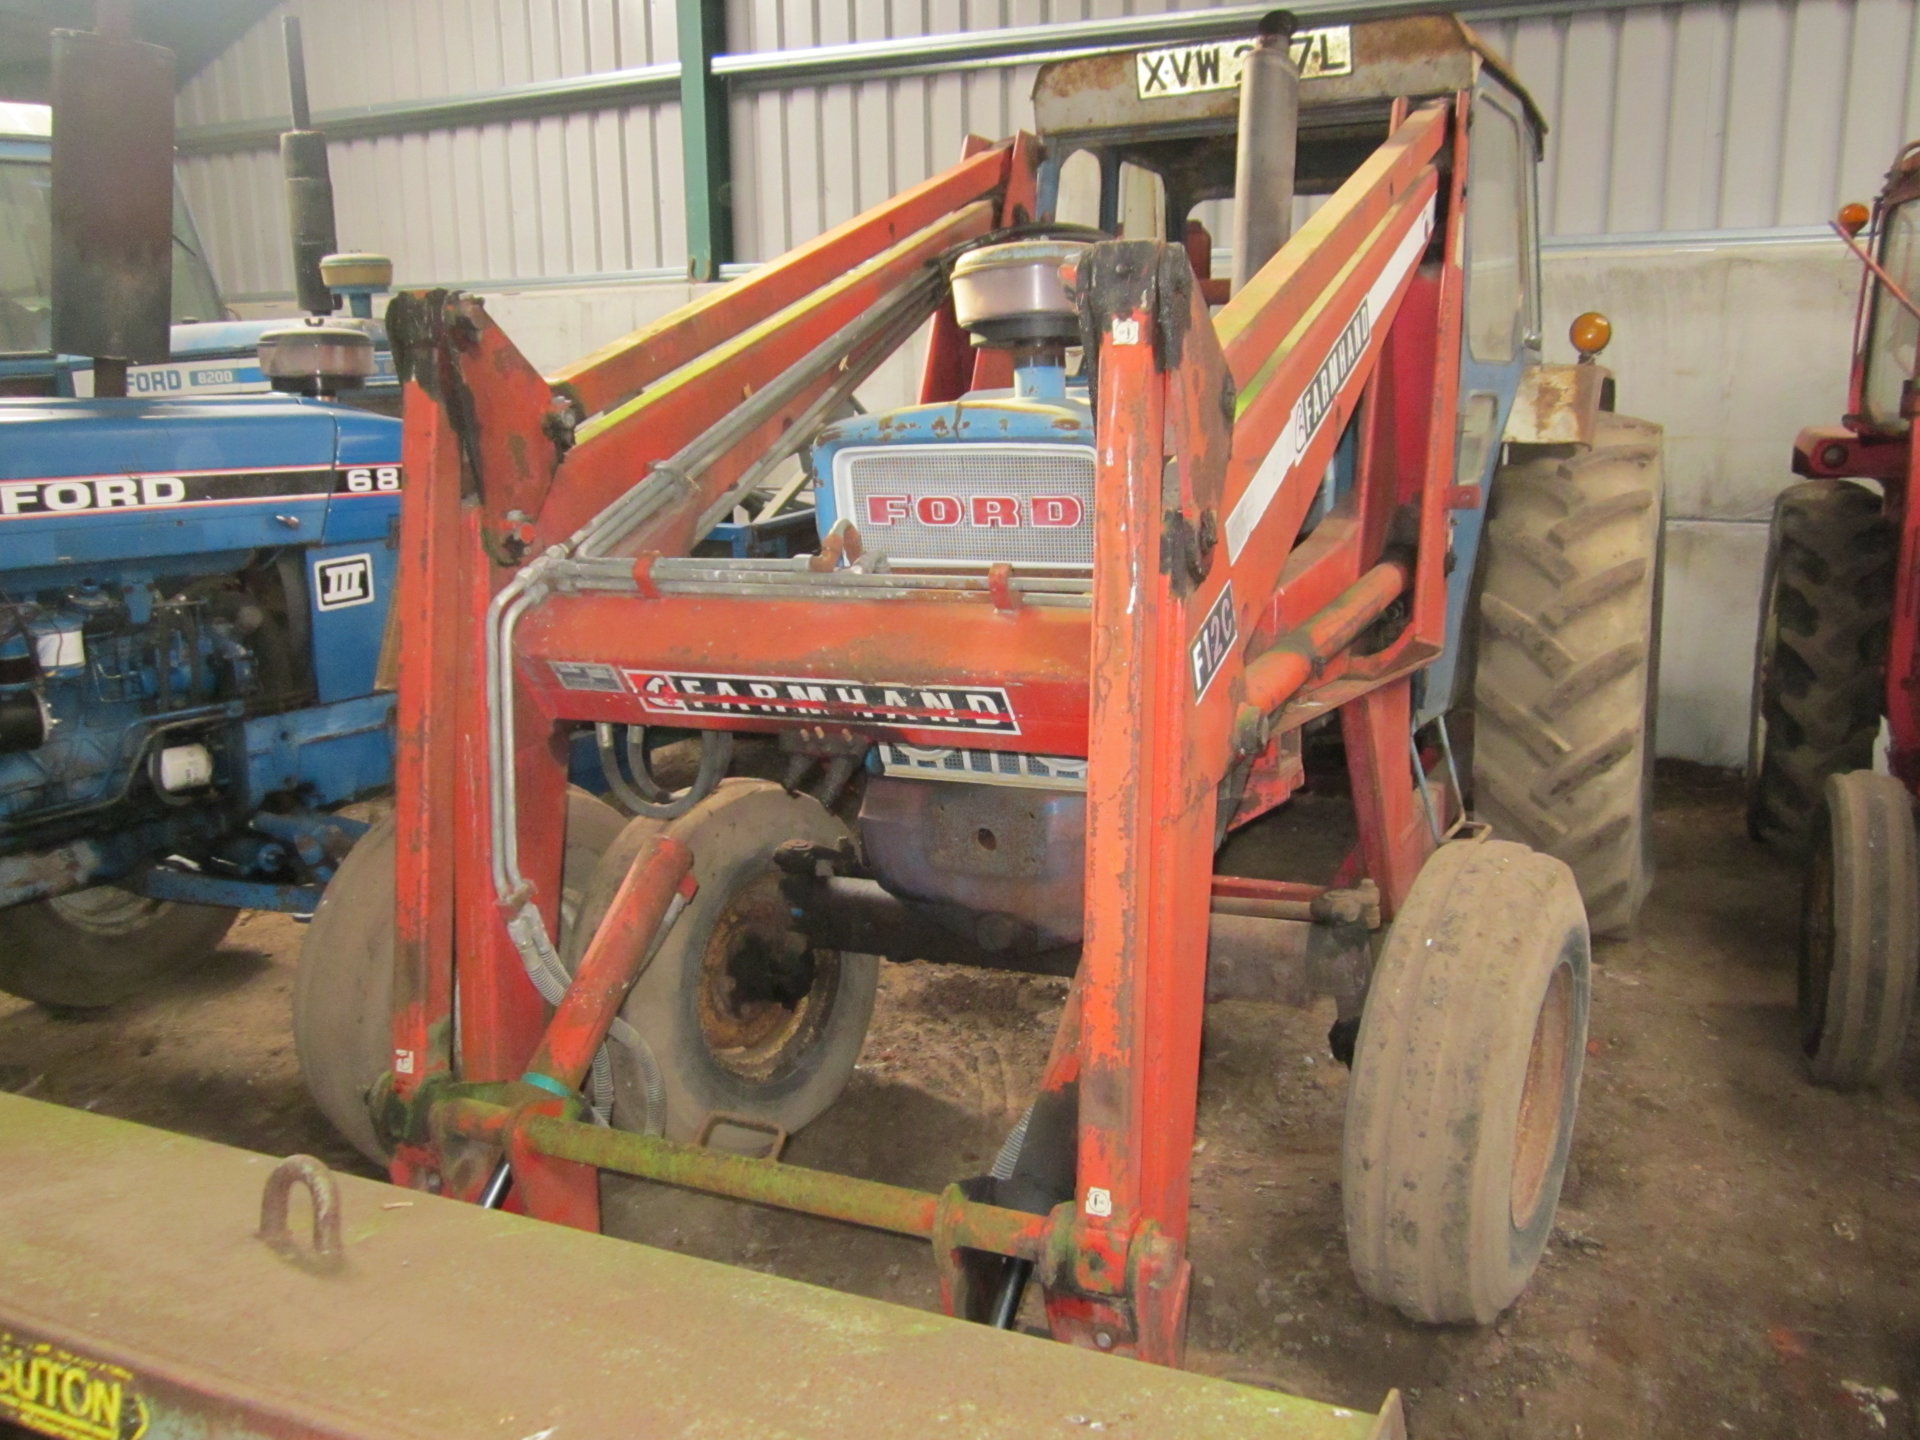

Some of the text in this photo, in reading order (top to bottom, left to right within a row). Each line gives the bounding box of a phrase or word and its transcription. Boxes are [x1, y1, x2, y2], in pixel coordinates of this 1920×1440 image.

[1142, 45, 1220, 92] XVW
[197, 370, 233, 384] 8200
[1304, 303, 1370, 434] FARMHAND
[1, 477, 186, 514] FORD
[866, 494, 1084, 528] FORD
[323, 564, 366, 602] III
[1192, 598, 1232, 691] F12C
[678, 679, 1001, 726] FARMHAND
